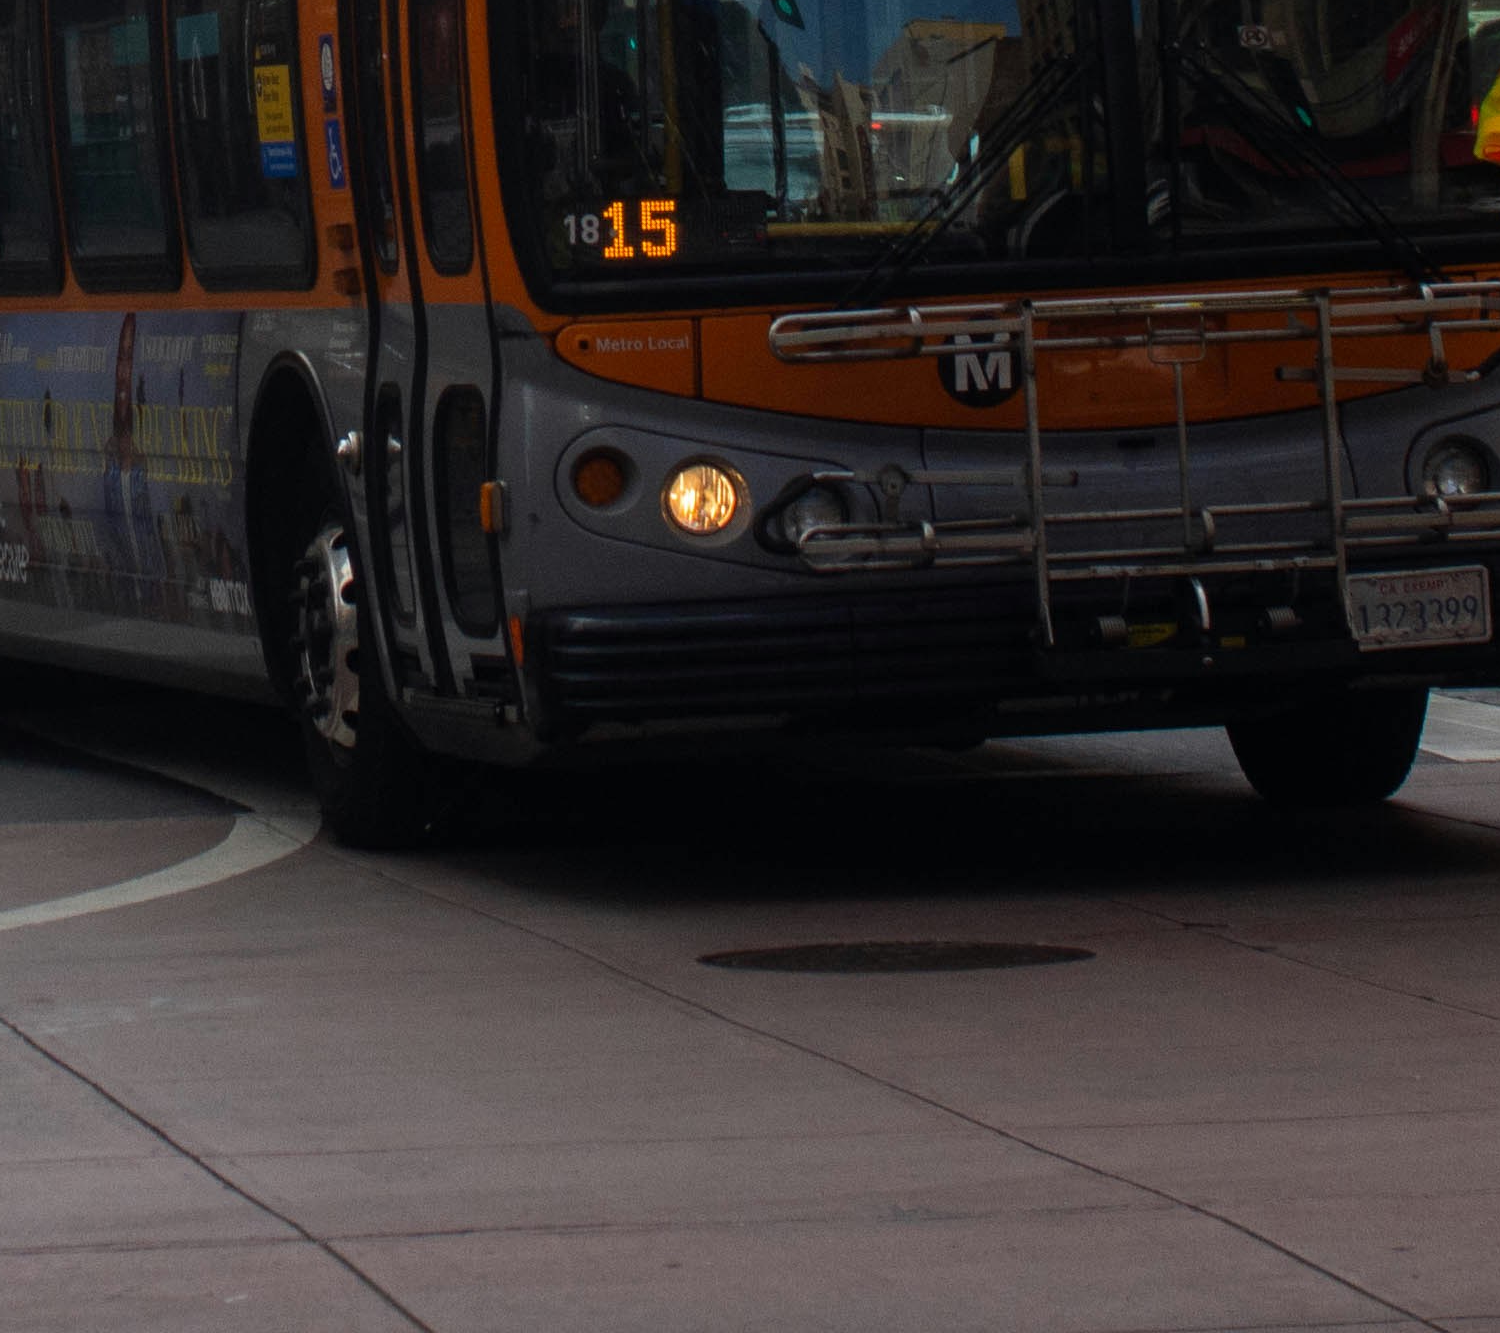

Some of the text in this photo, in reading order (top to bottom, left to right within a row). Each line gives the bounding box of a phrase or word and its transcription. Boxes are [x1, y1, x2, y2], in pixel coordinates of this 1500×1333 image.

[563, 213, 600, 246] 18
[602, 198, 678, 260] 15
[595, 334, 691, 355] Metro Local
[1379, 580, 1399, 595] CA
